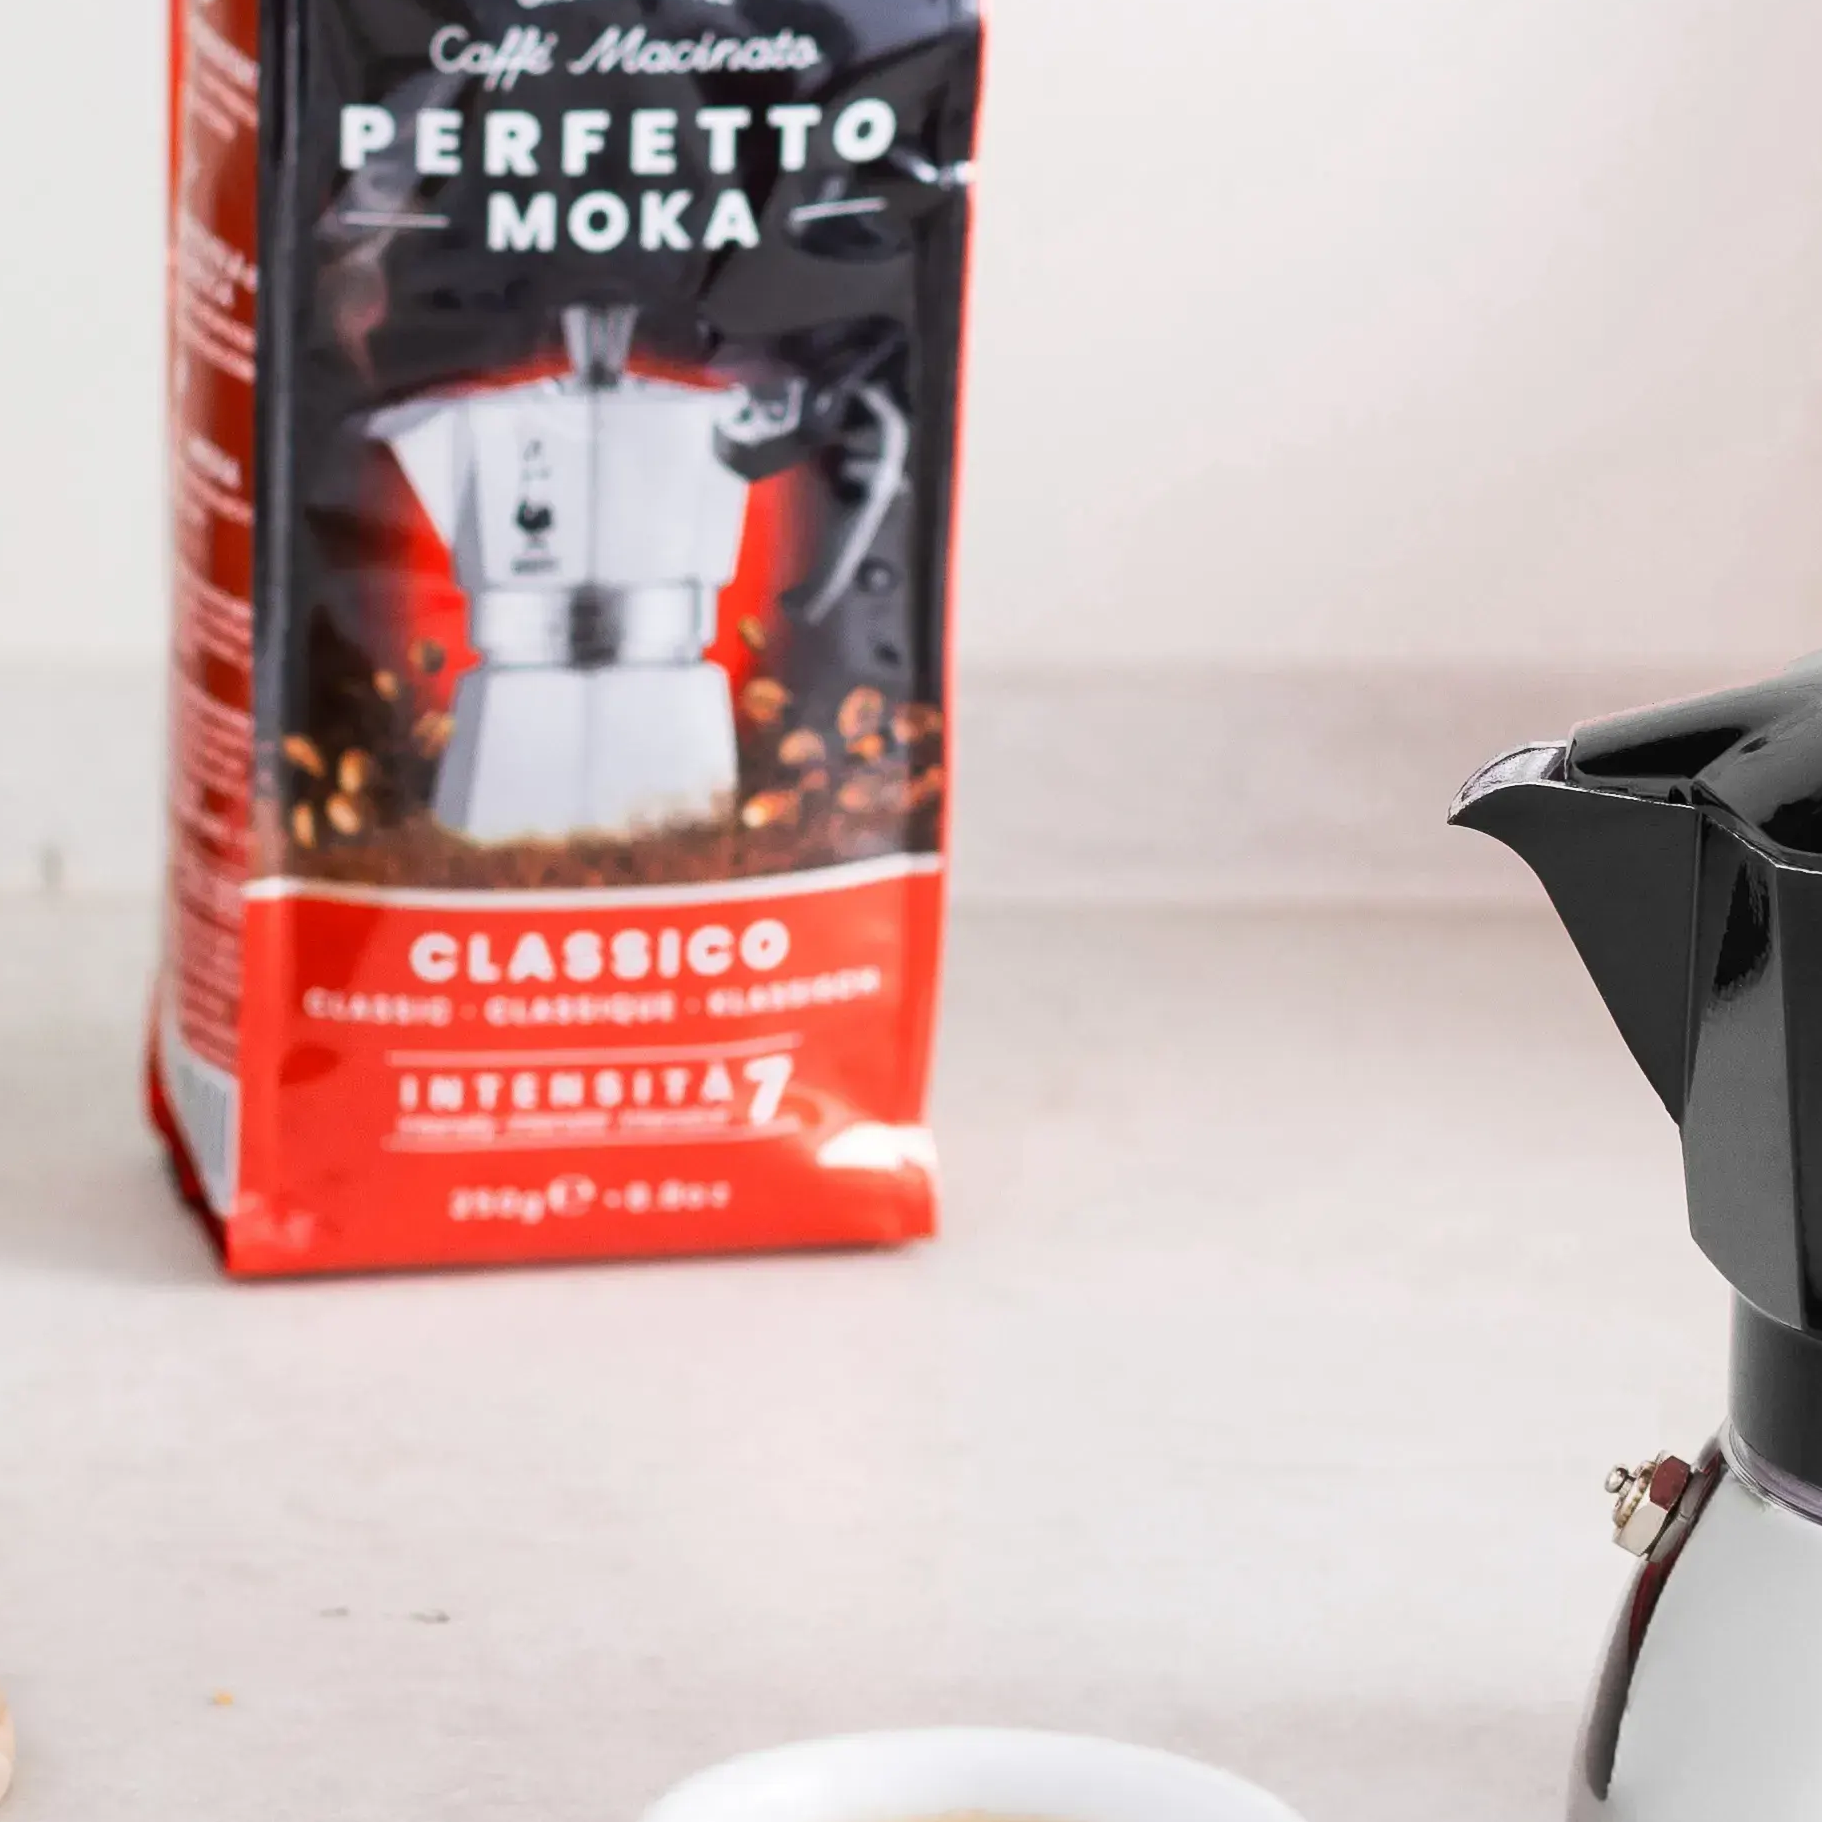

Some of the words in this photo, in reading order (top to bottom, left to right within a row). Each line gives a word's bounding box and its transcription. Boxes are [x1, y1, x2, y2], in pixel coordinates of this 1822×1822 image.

[567, 23, 821, 75] Macinato
[339, 97, 897, 176] PERFETTO
[487, 188, 761, 253] MOKA
[409, 918, 791, 984] CLASSICO
[742, 1051, 795, 1127] 7
